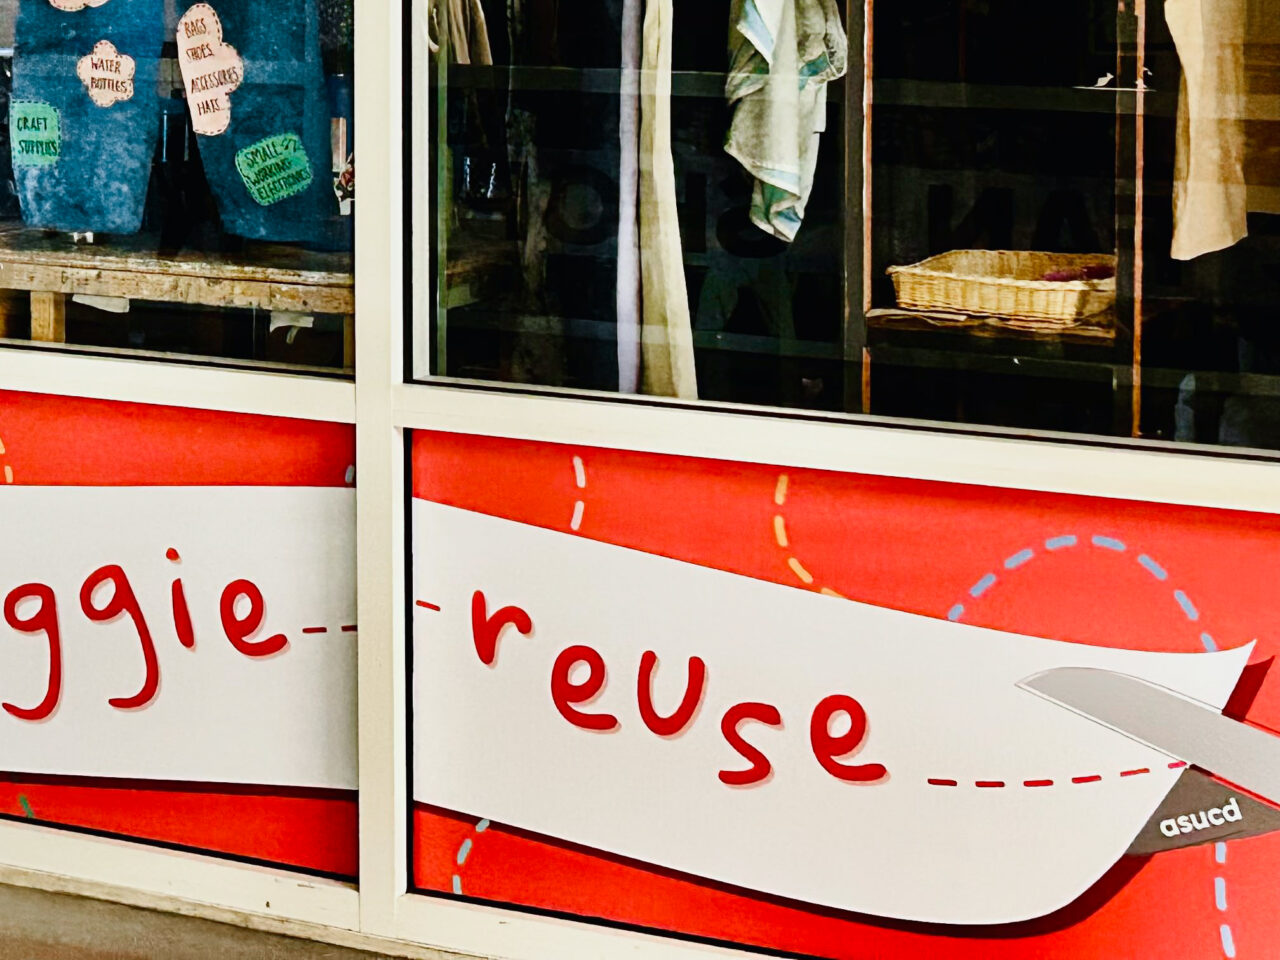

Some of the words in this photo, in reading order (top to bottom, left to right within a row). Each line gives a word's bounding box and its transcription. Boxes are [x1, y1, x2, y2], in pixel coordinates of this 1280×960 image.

[91, 57, 121, 74] WATER
[16, 116, 48, 132] CRAFT
[244, 141, 283, 169] SMALL
[471, 589, 888, 786] reuse
[1159, 797, 1243, 837] asucd
